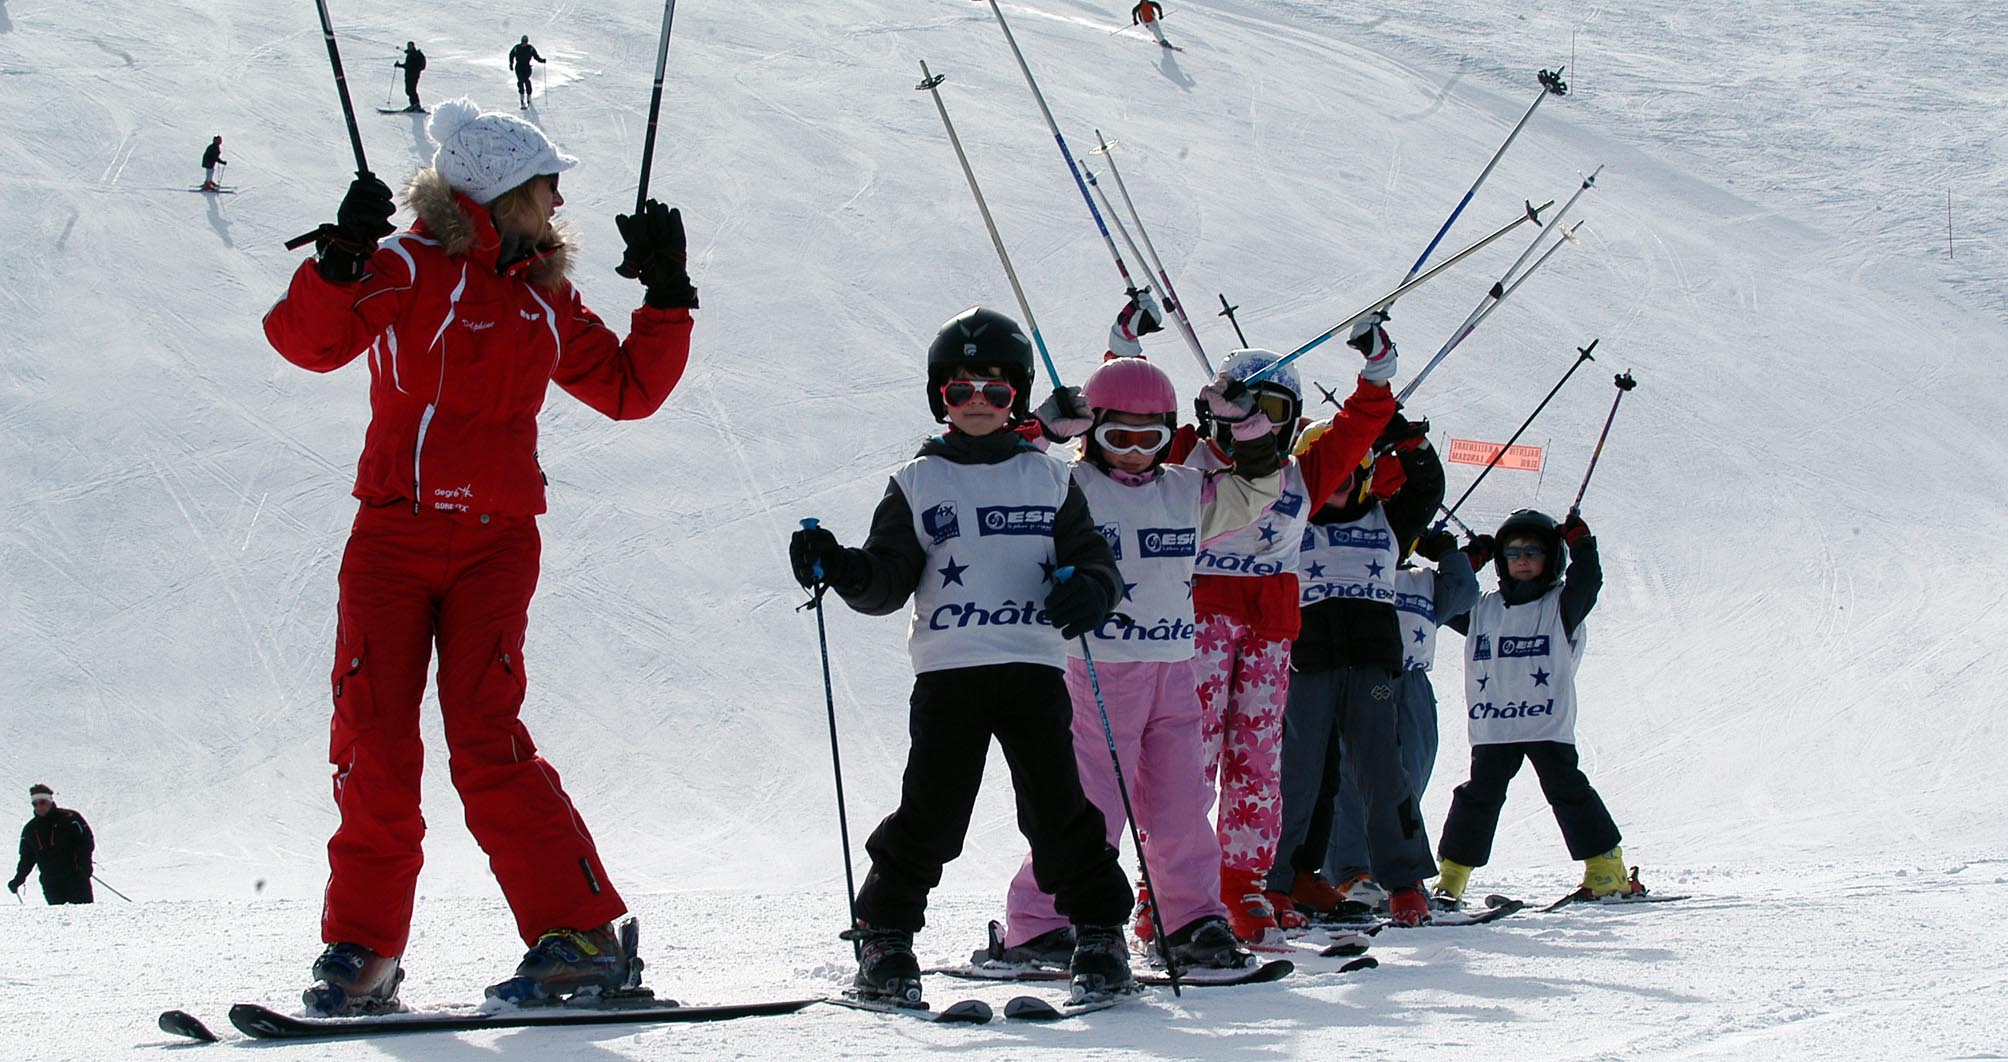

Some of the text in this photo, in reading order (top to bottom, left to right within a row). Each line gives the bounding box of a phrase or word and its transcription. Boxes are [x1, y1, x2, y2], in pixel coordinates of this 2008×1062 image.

[1007, 511, 1056, 523] ESF
[1195, 548, 1283, 576] hâtel
[929, 599, 1053, 631] Châte
[1094, 618, 1195, 641] Châte
[1469, 699, 1554, 720] Châtel
